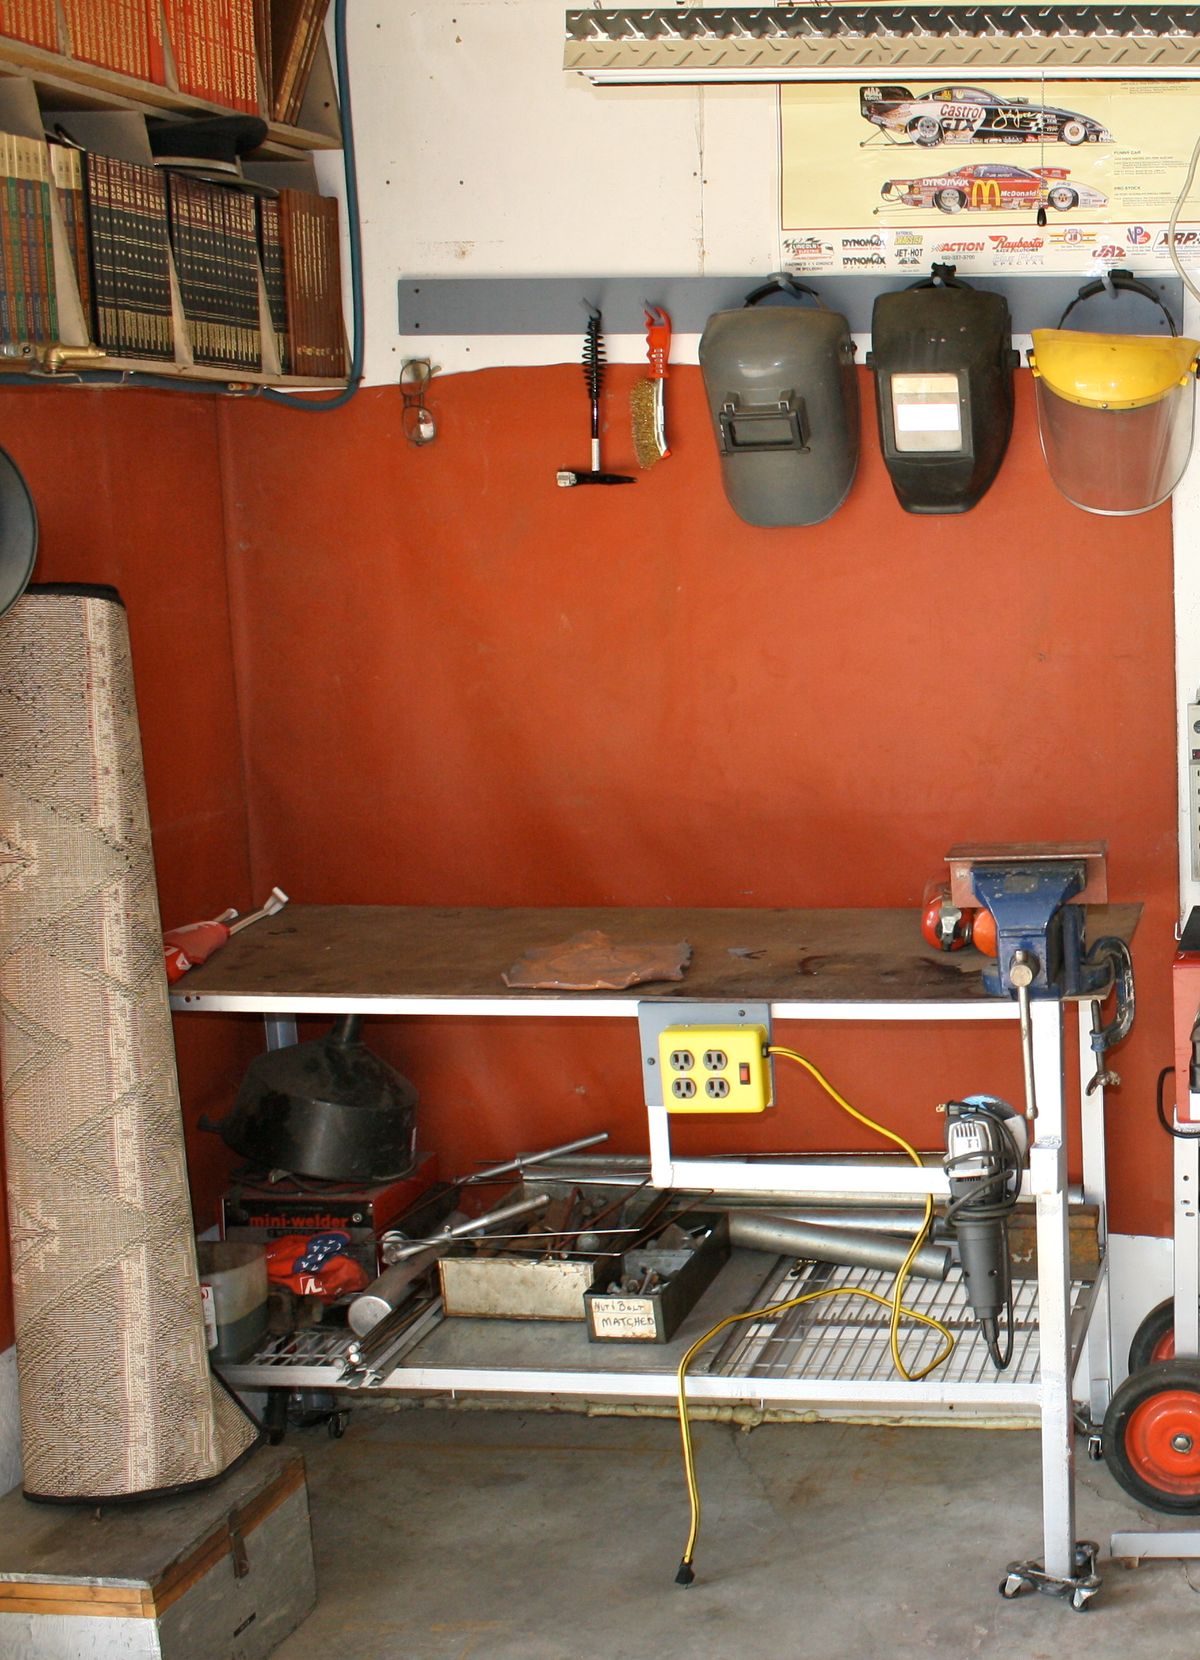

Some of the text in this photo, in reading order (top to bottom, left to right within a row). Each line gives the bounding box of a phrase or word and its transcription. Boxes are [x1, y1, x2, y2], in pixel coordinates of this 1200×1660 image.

[940, 104, 983, 119] Castrol
[942, 118, 978, 132] GTX
[895, 249, 923, 257] JET-HOT
[941, 242, 985, 252] ACTION
[842, 253, 886, 265] DYNOMAX
[595, 1301, 610, 1311] NUT
[602, 1316, 655, 1328] MATCHED
